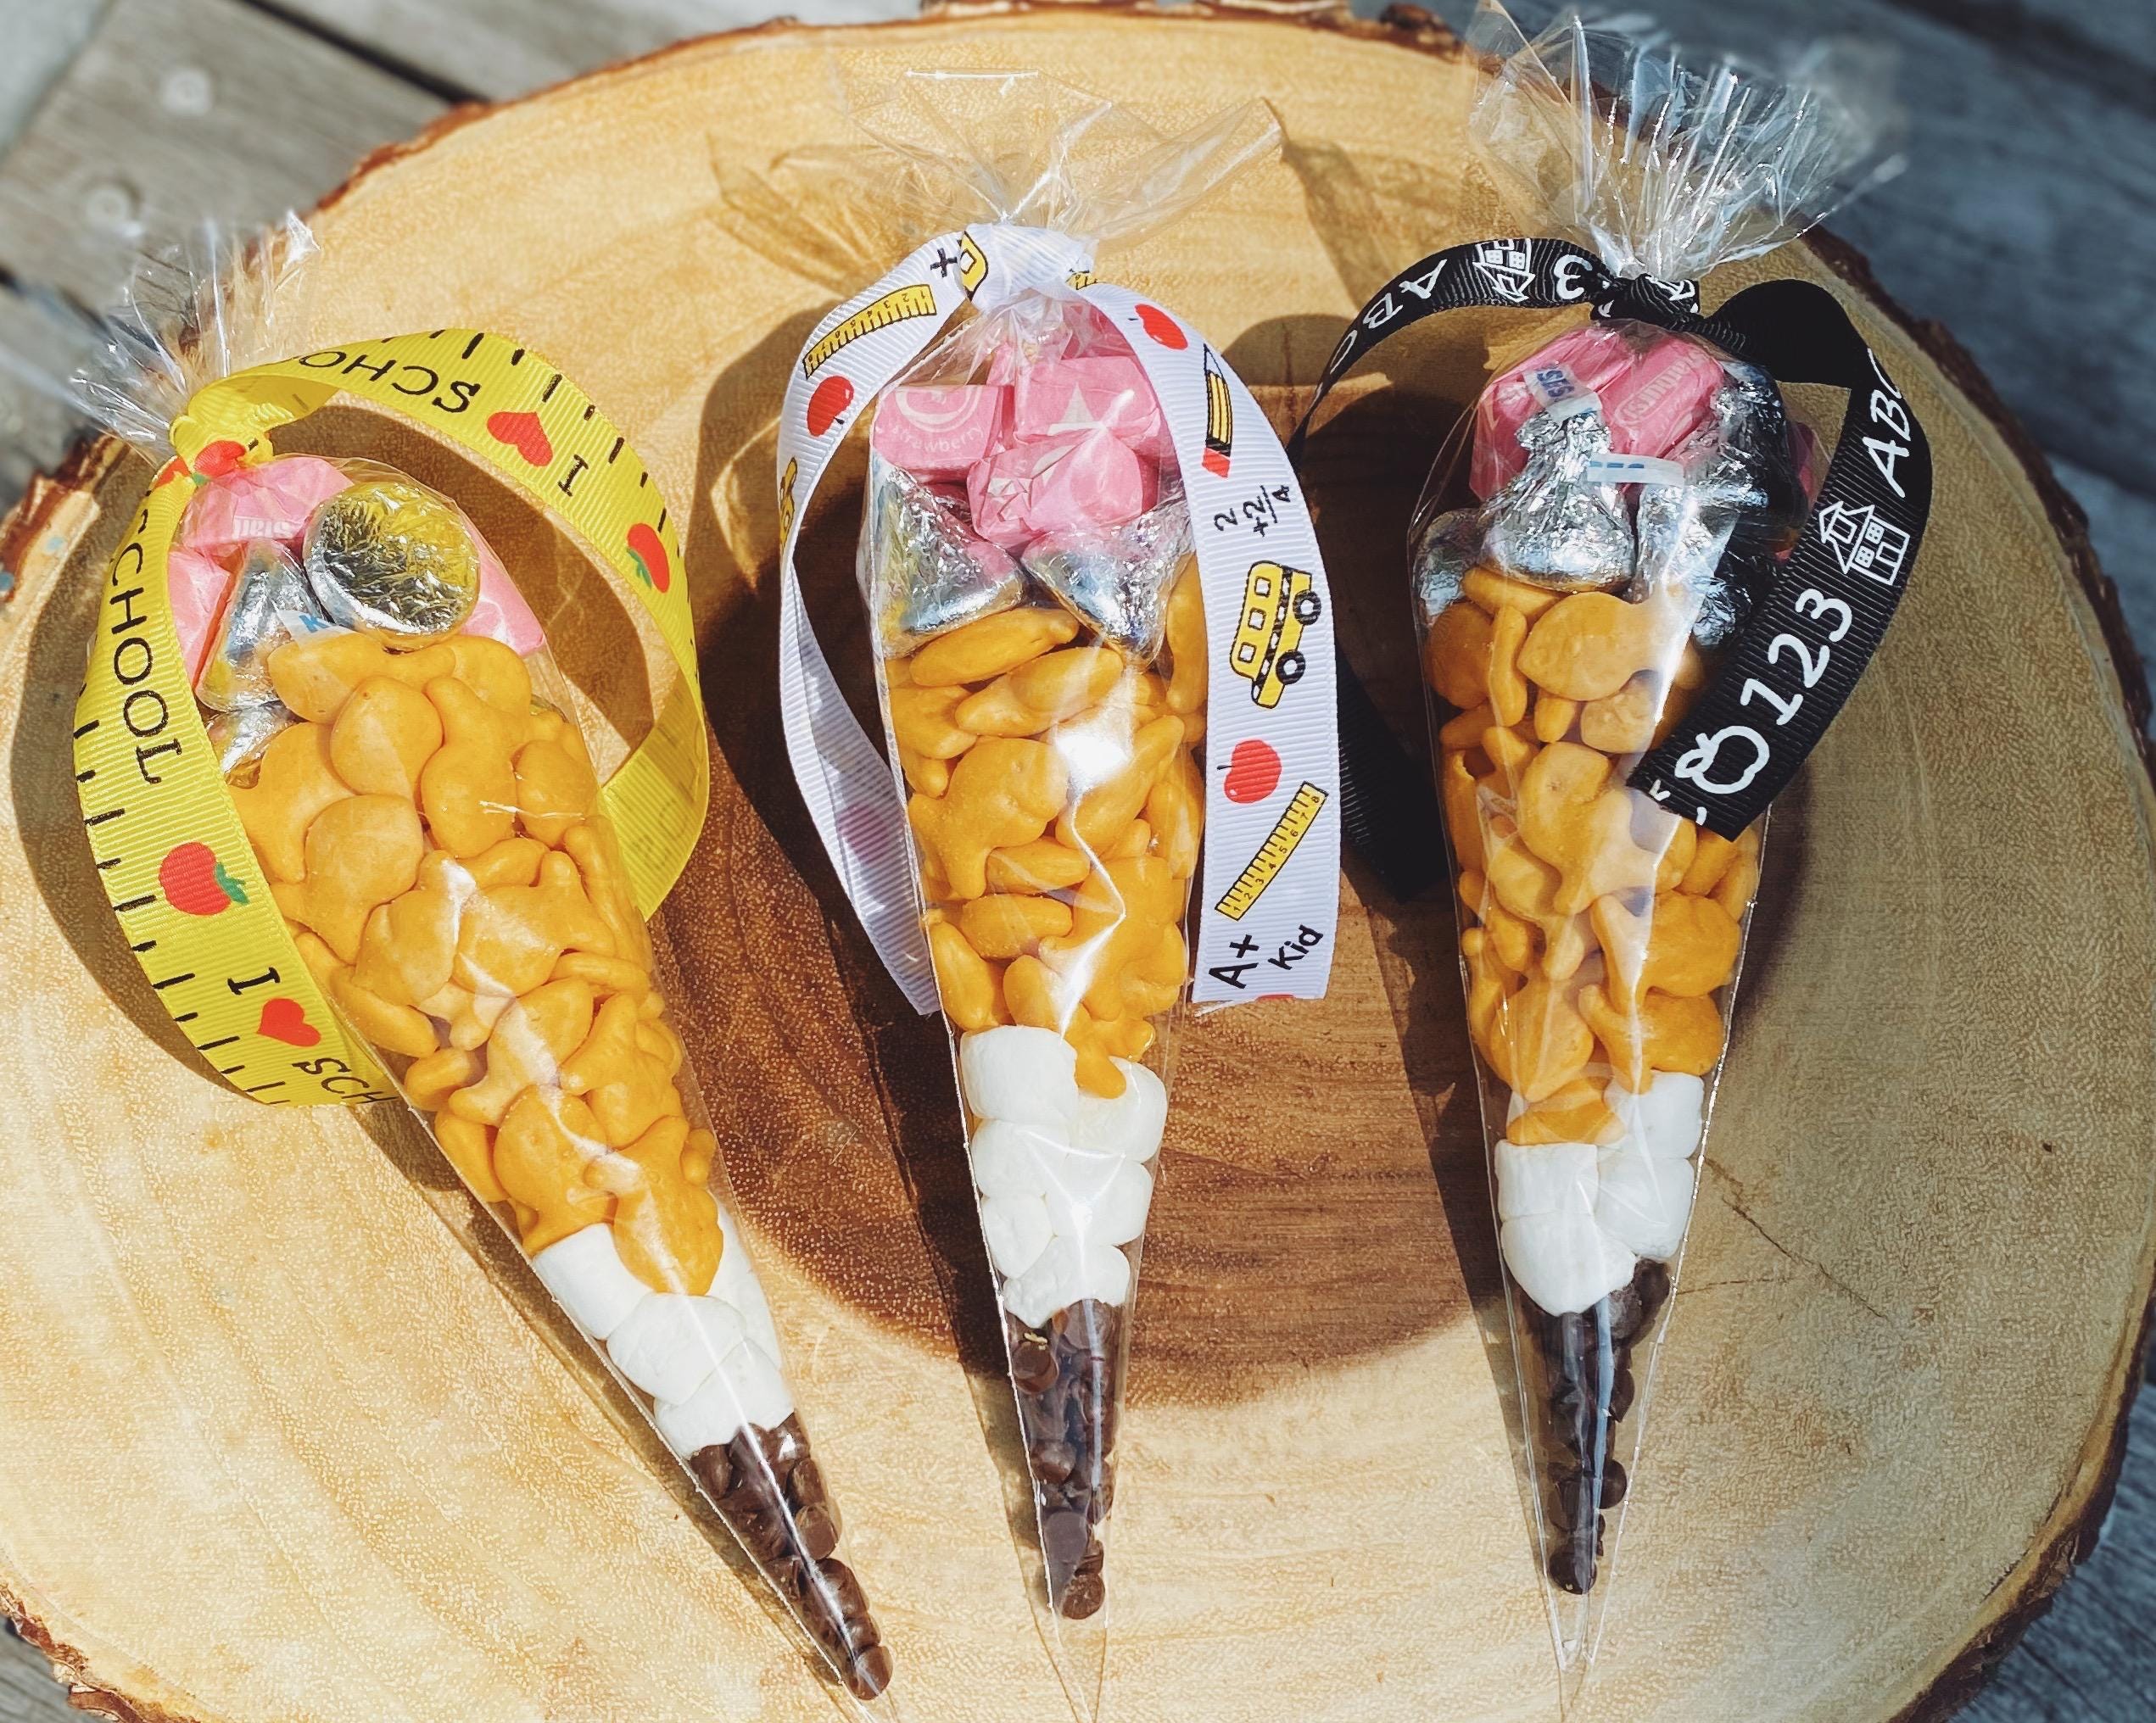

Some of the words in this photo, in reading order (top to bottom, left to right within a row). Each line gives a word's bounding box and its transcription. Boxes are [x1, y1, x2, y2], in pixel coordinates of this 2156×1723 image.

[558, 454, 589, 497] I
[1214, 508, 1238, 532] 2
[1740, 588, 1852, 726] 123
[1209, 934, 1260, 990] A+
[1267, 924, 1323, 970] Kid
[227, 967, 281, 995] I
